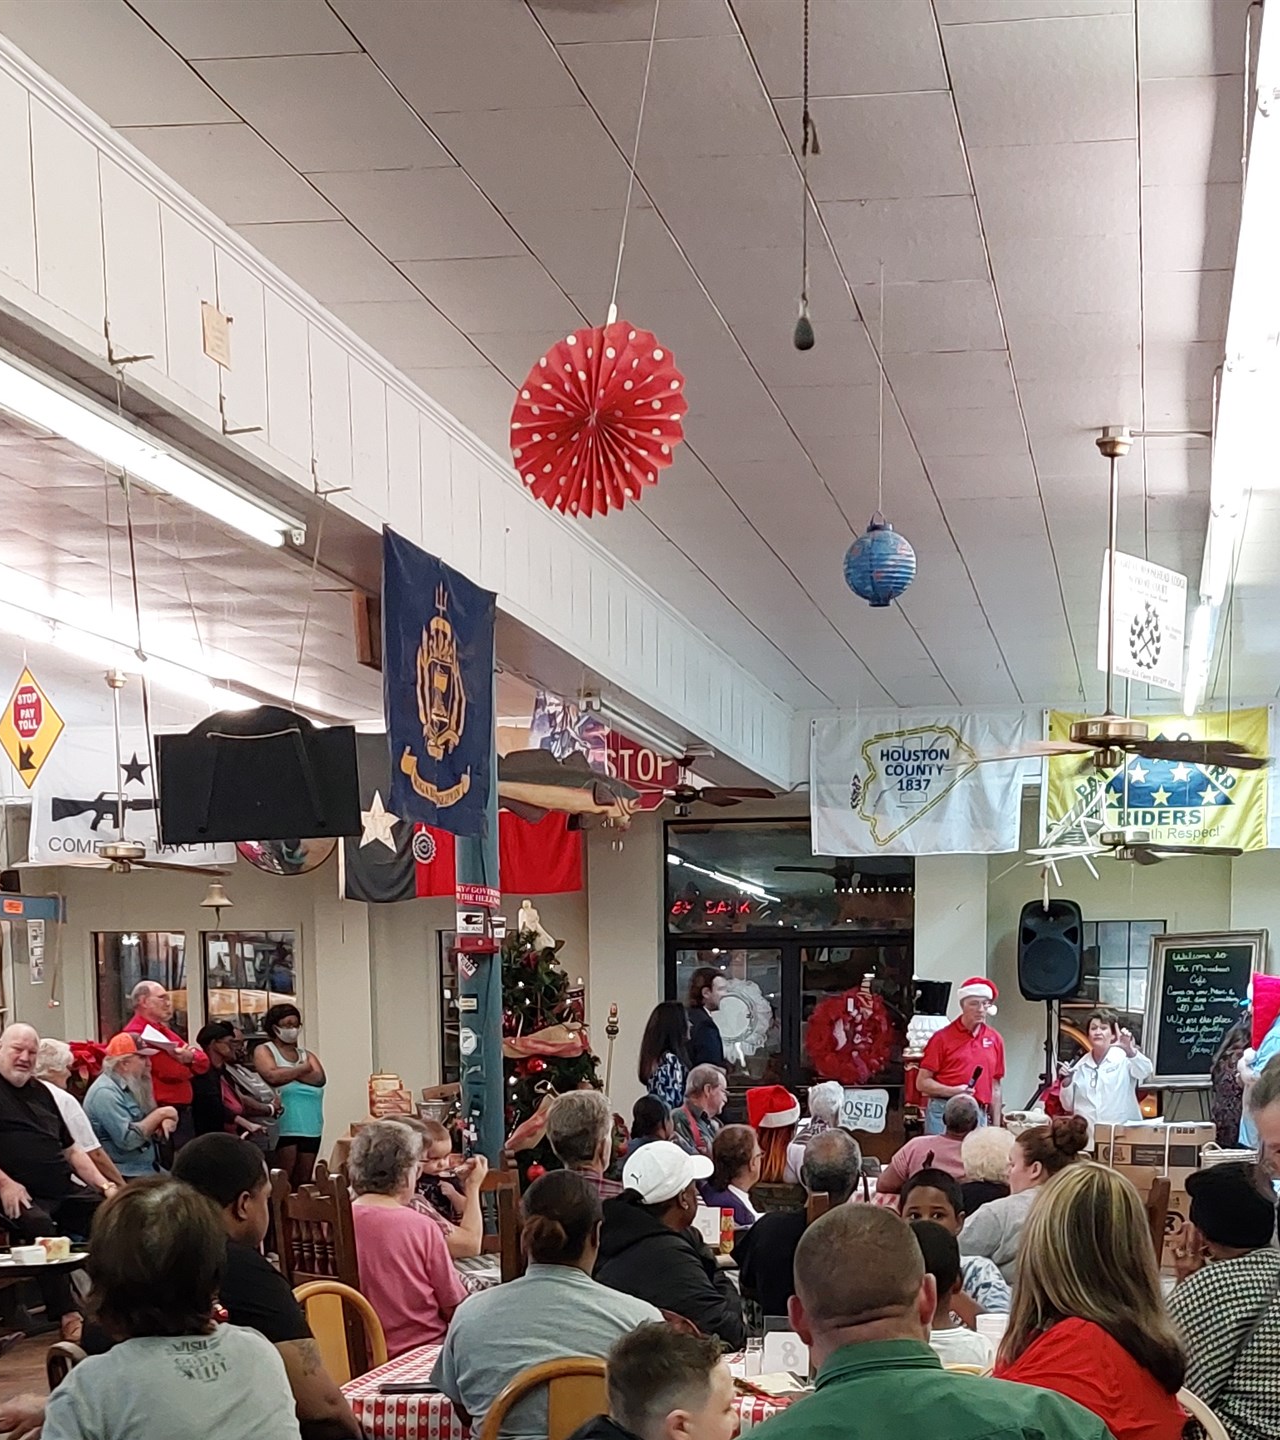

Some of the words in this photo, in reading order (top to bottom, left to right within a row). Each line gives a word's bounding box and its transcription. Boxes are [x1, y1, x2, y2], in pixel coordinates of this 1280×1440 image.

[17, 692, 37, 705] STOP
[20, 708, 35, 719] PAY
[18, 719, 37, 730] TOLL
[880, 748, 950, 762] HOUSTON
[884, 764, 944, 776] COUNTY
[897, 779, 931, 791] 1837
[1118, 810, 1202, 826] RIDERS
[48, 836, 104, 854] COME
[844, 1101, 883, 1119] OSED
